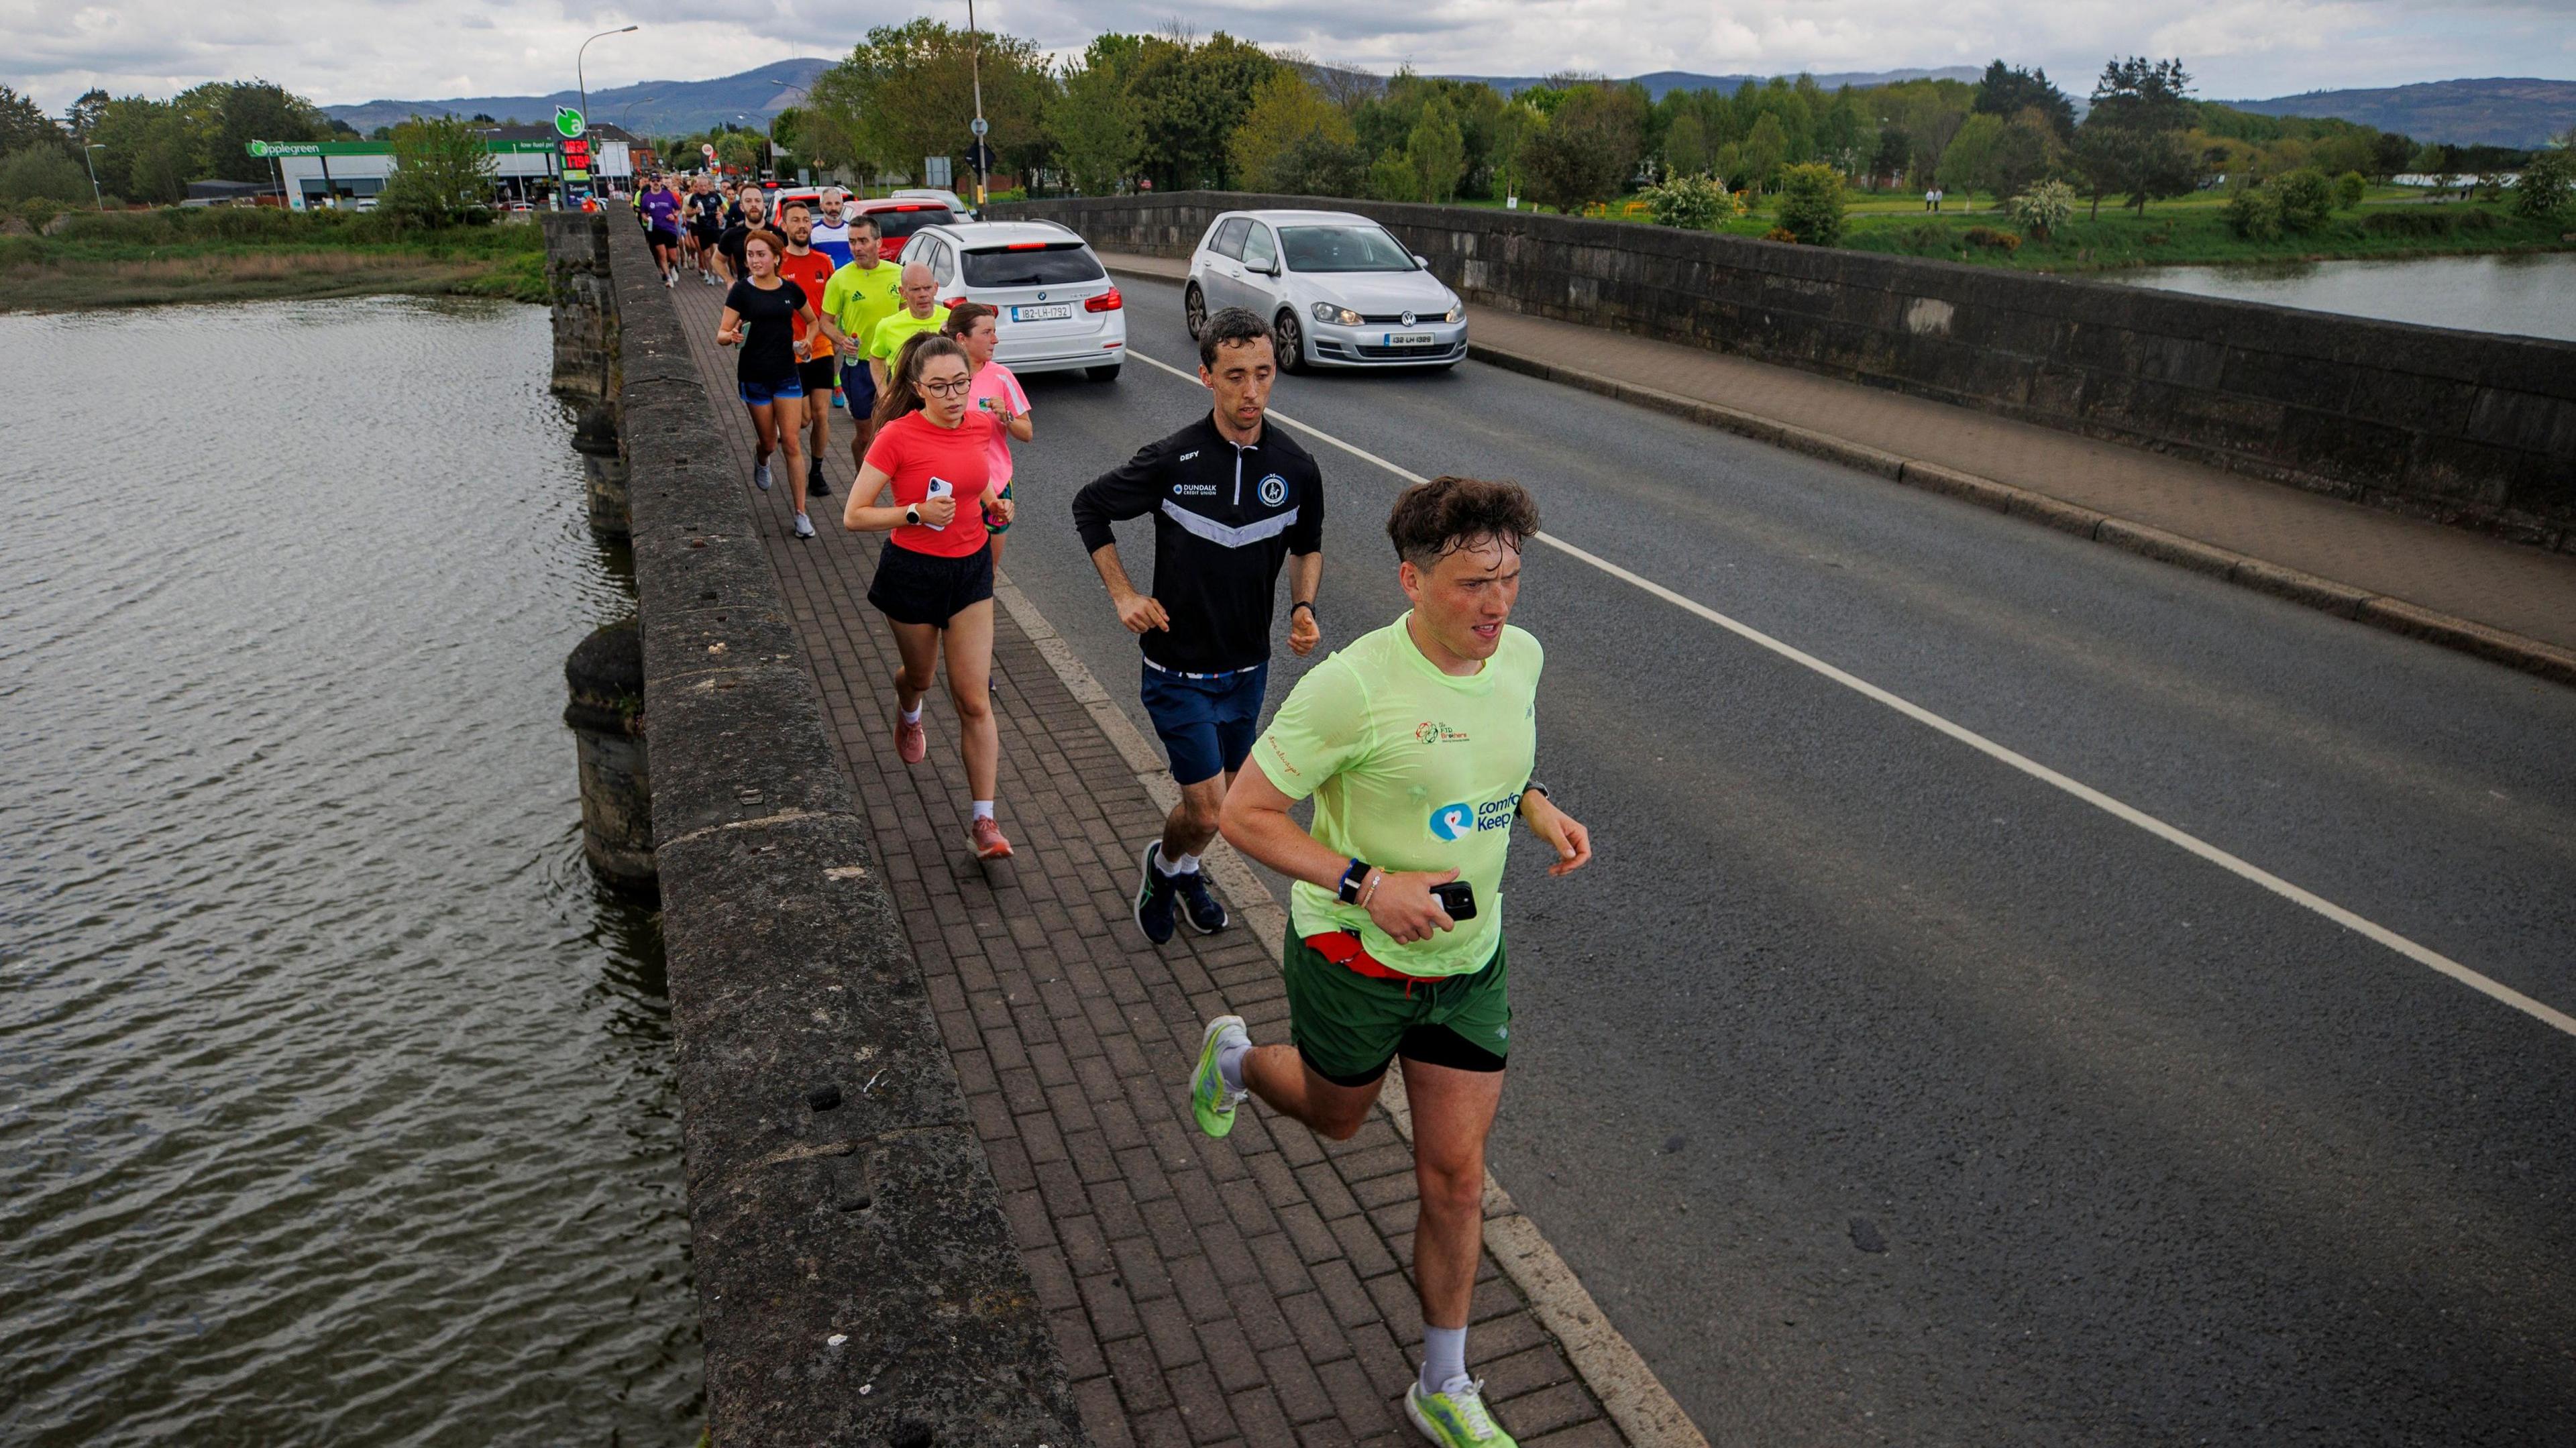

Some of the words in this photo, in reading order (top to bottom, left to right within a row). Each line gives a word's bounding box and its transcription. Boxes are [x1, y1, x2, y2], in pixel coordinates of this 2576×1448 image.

[260, 144, 320, 156] applegreen
[1022, 307, 1067, 319] 182-LH-1792
[1180, 450, 1199, 462] DEFY
[1478, 813, 1511, 832] Keep
